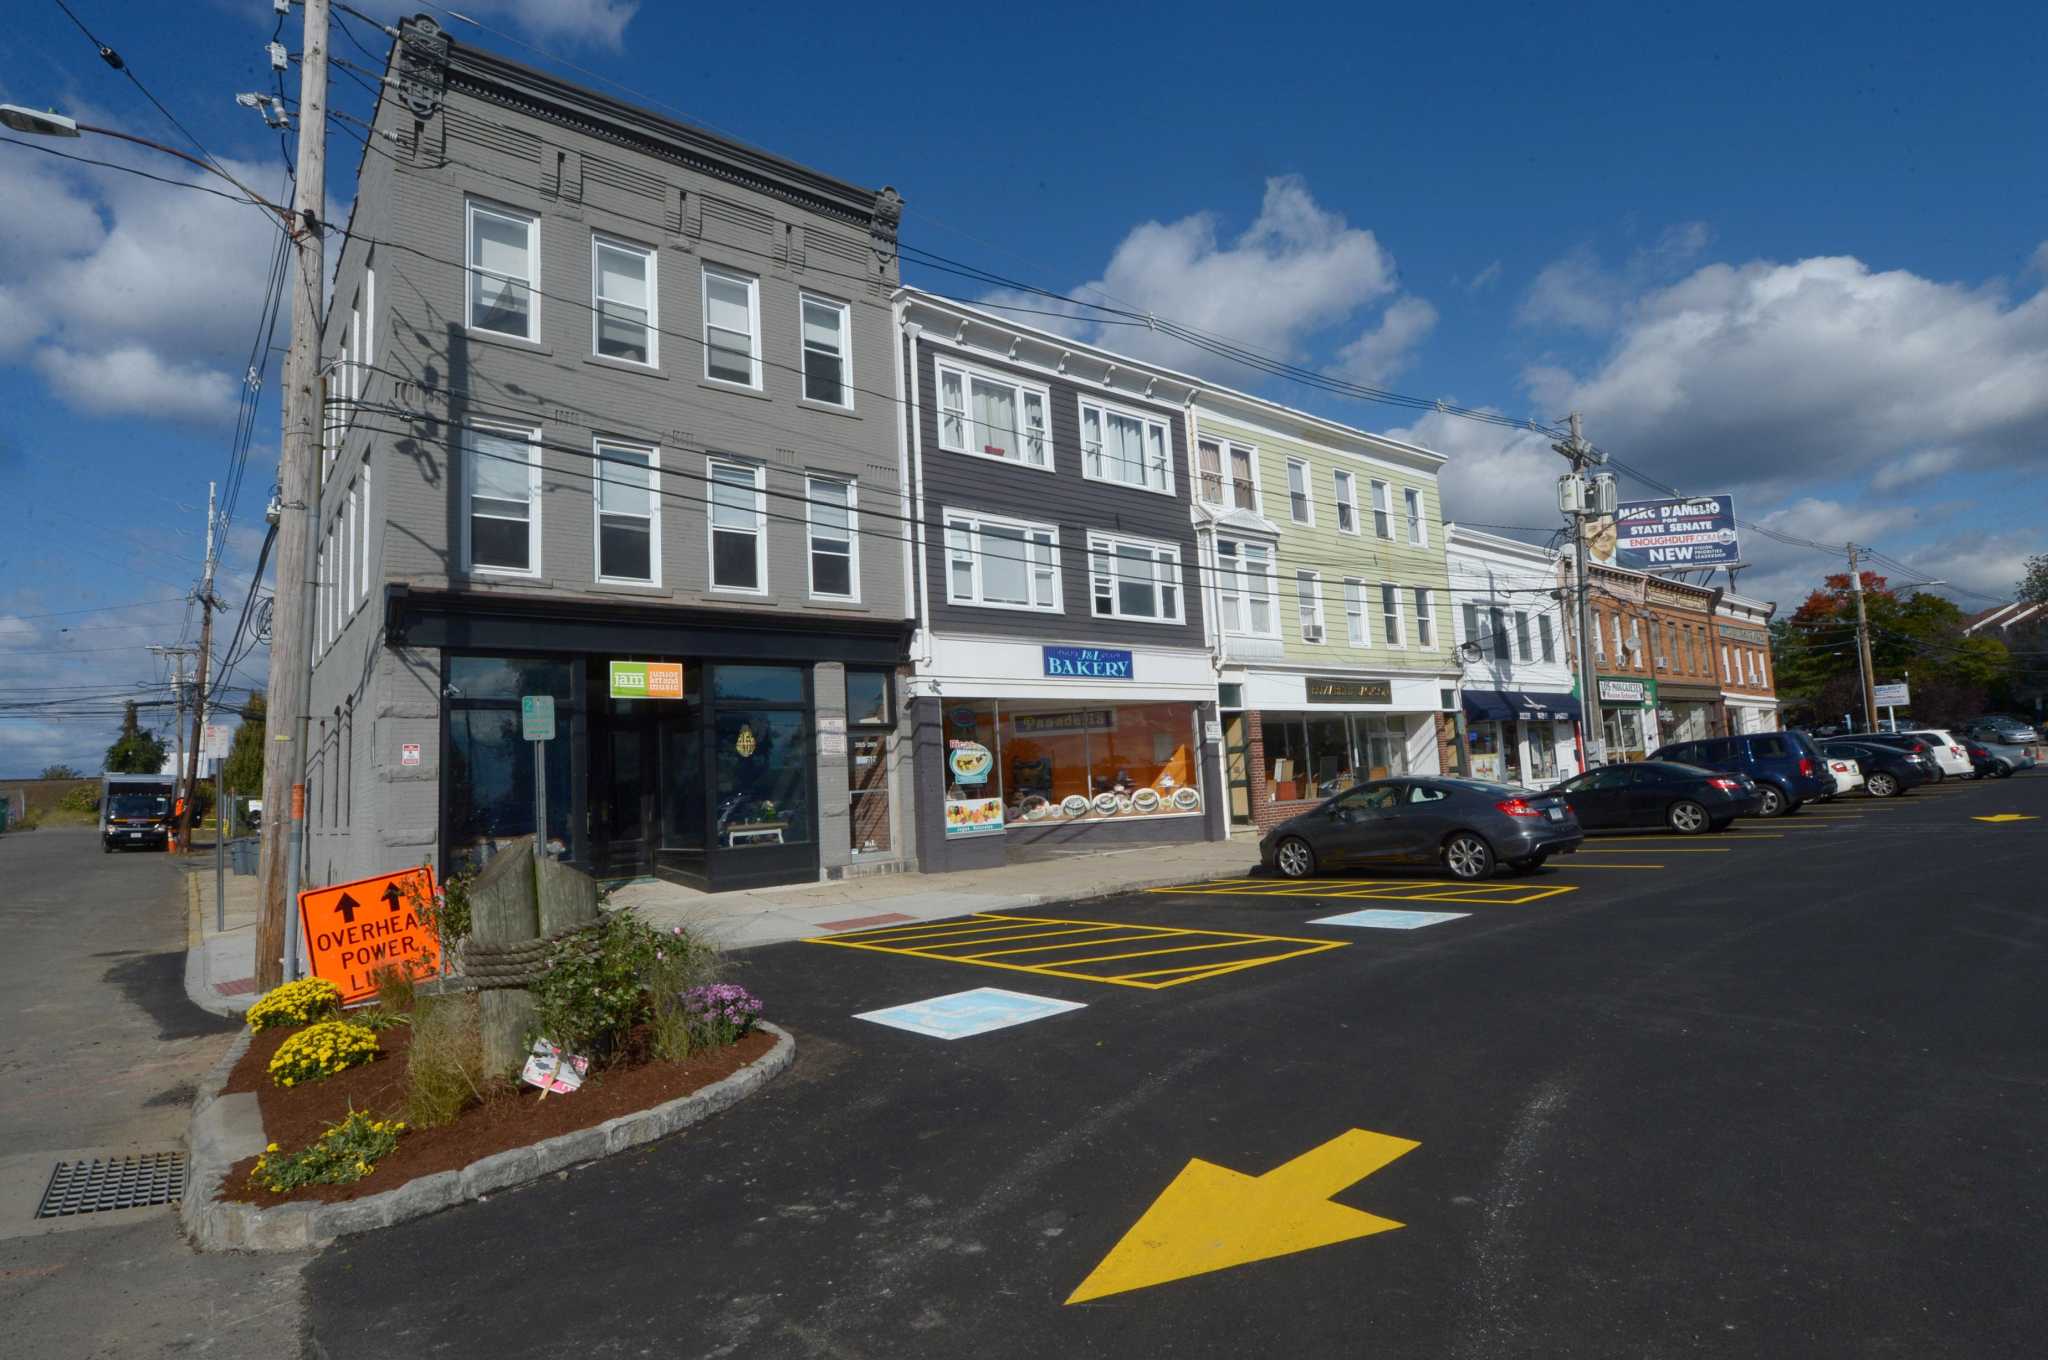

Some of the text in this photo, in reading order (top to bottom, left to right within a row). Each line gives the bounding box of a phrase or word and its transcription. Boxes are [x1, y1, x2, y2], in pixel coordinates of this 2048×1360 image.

[1618, 501, 1720, 520] MARC D'AMELIO
[1630, 521, 1712, 535] STATE SENATE
[1649, 546, 1694, 562] NEW
[1048, 656, 1129, 677] BAKERY
[317, 912, 421, 951] OVERHEA
[341, 936, 415, 969] POWER
